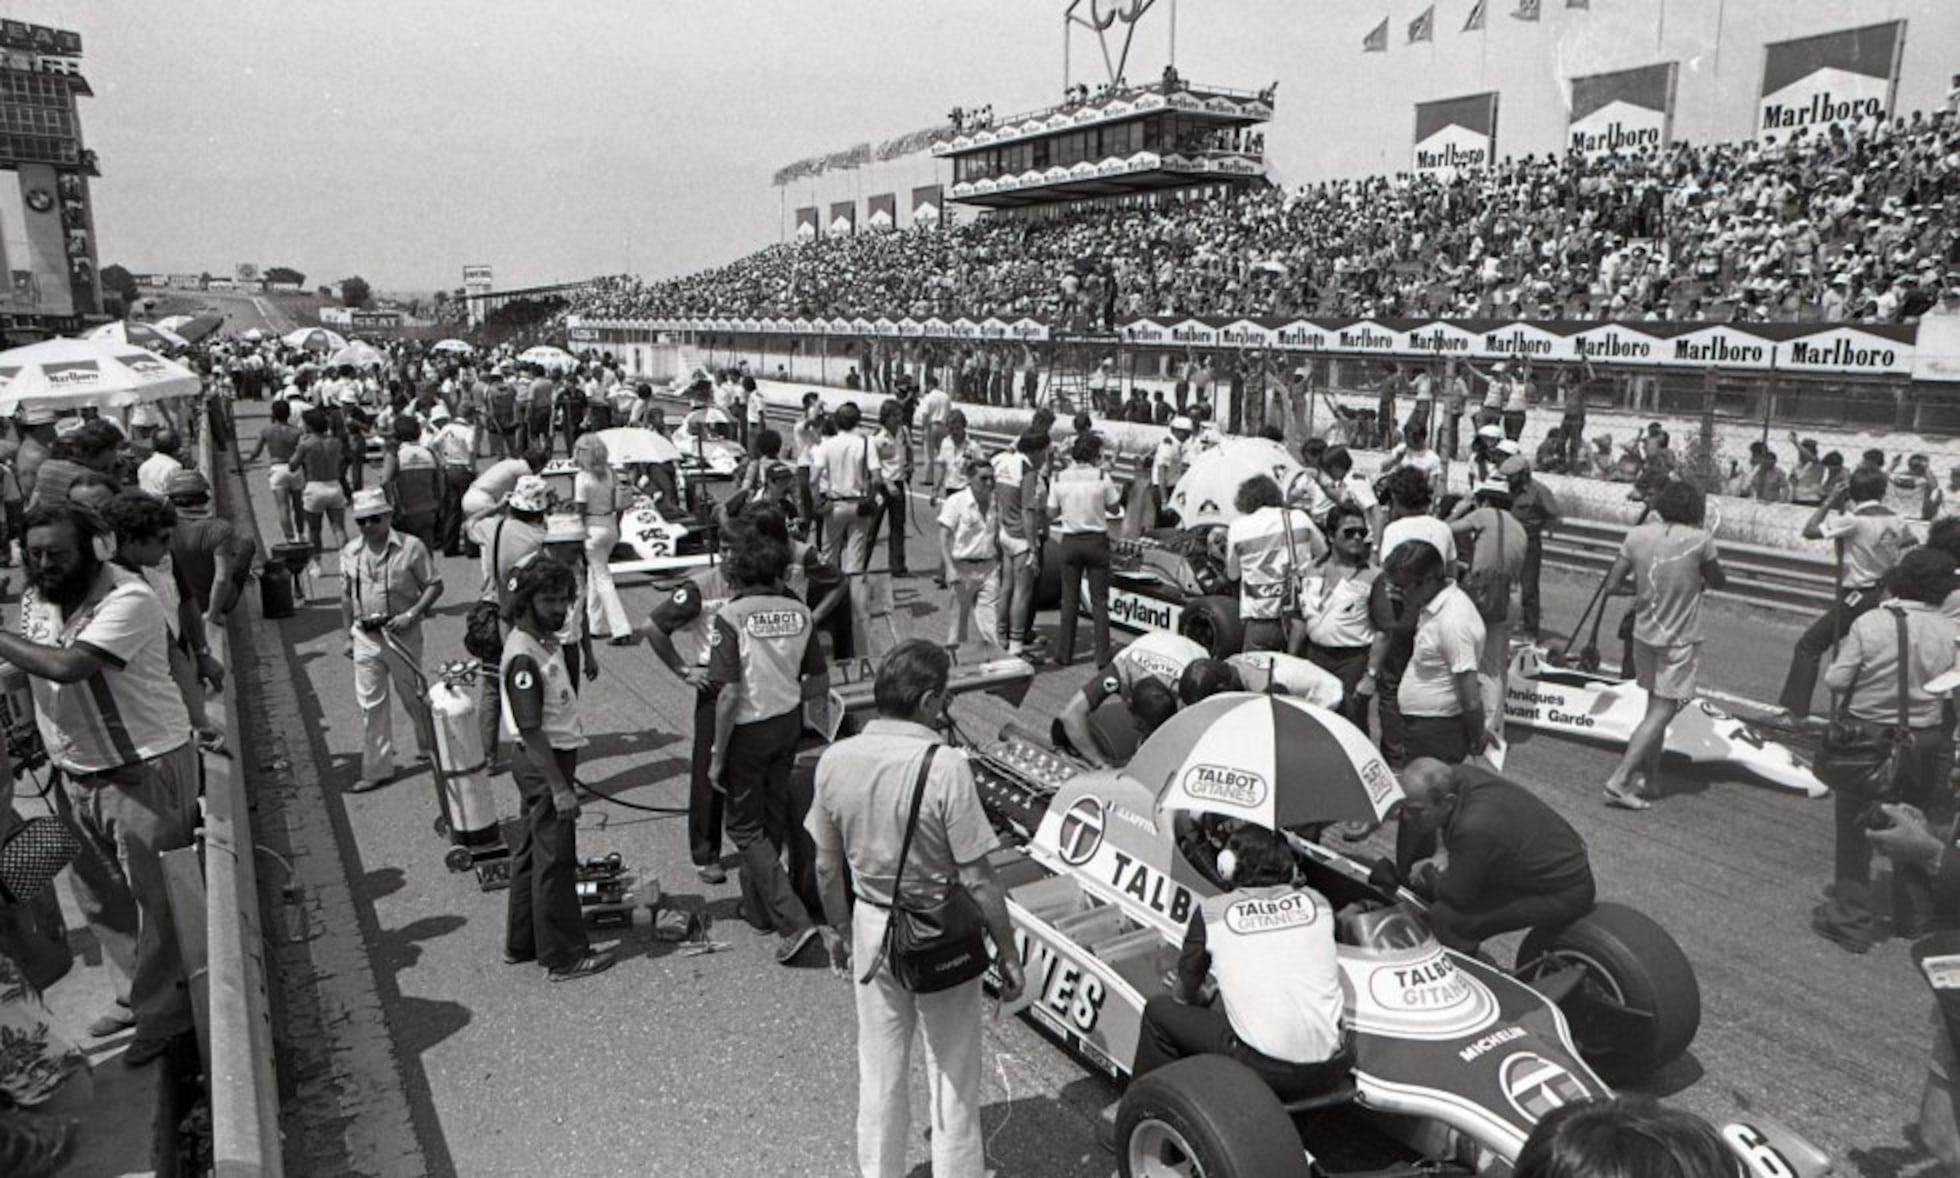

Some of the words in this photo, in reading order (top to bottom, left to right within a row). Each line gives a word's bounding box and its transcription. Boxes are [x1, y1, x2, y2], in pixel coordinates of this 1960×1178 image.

[1762, 92, 1880, 130] Marlboro
[1572, 121, 1659, 154] Marlboro
[1416, 142, 1484, 169] Marlboro
[1172, 324, 1211, 342] Marlboro
[1278, 325, 1325, 346] Marlboro
[1340, 327, 1393, 349] Marlboro
[1409, 329, 1468, 351] Marlboro
[1485, 331, 1552, 354] Marlboro
[1573, 332, 1650, 357] Marlboro
[1674, 336, 1762, 363] Marlboro
[1791, 338, 1895, 367] Marlboro
[1109, 598, 1170, 630] eyland
[1548, 709, 1595, 727] Garde
[1197, 768, 1259, 790] TALBOT
[1235, 895, 1302, 917] TALBOT
